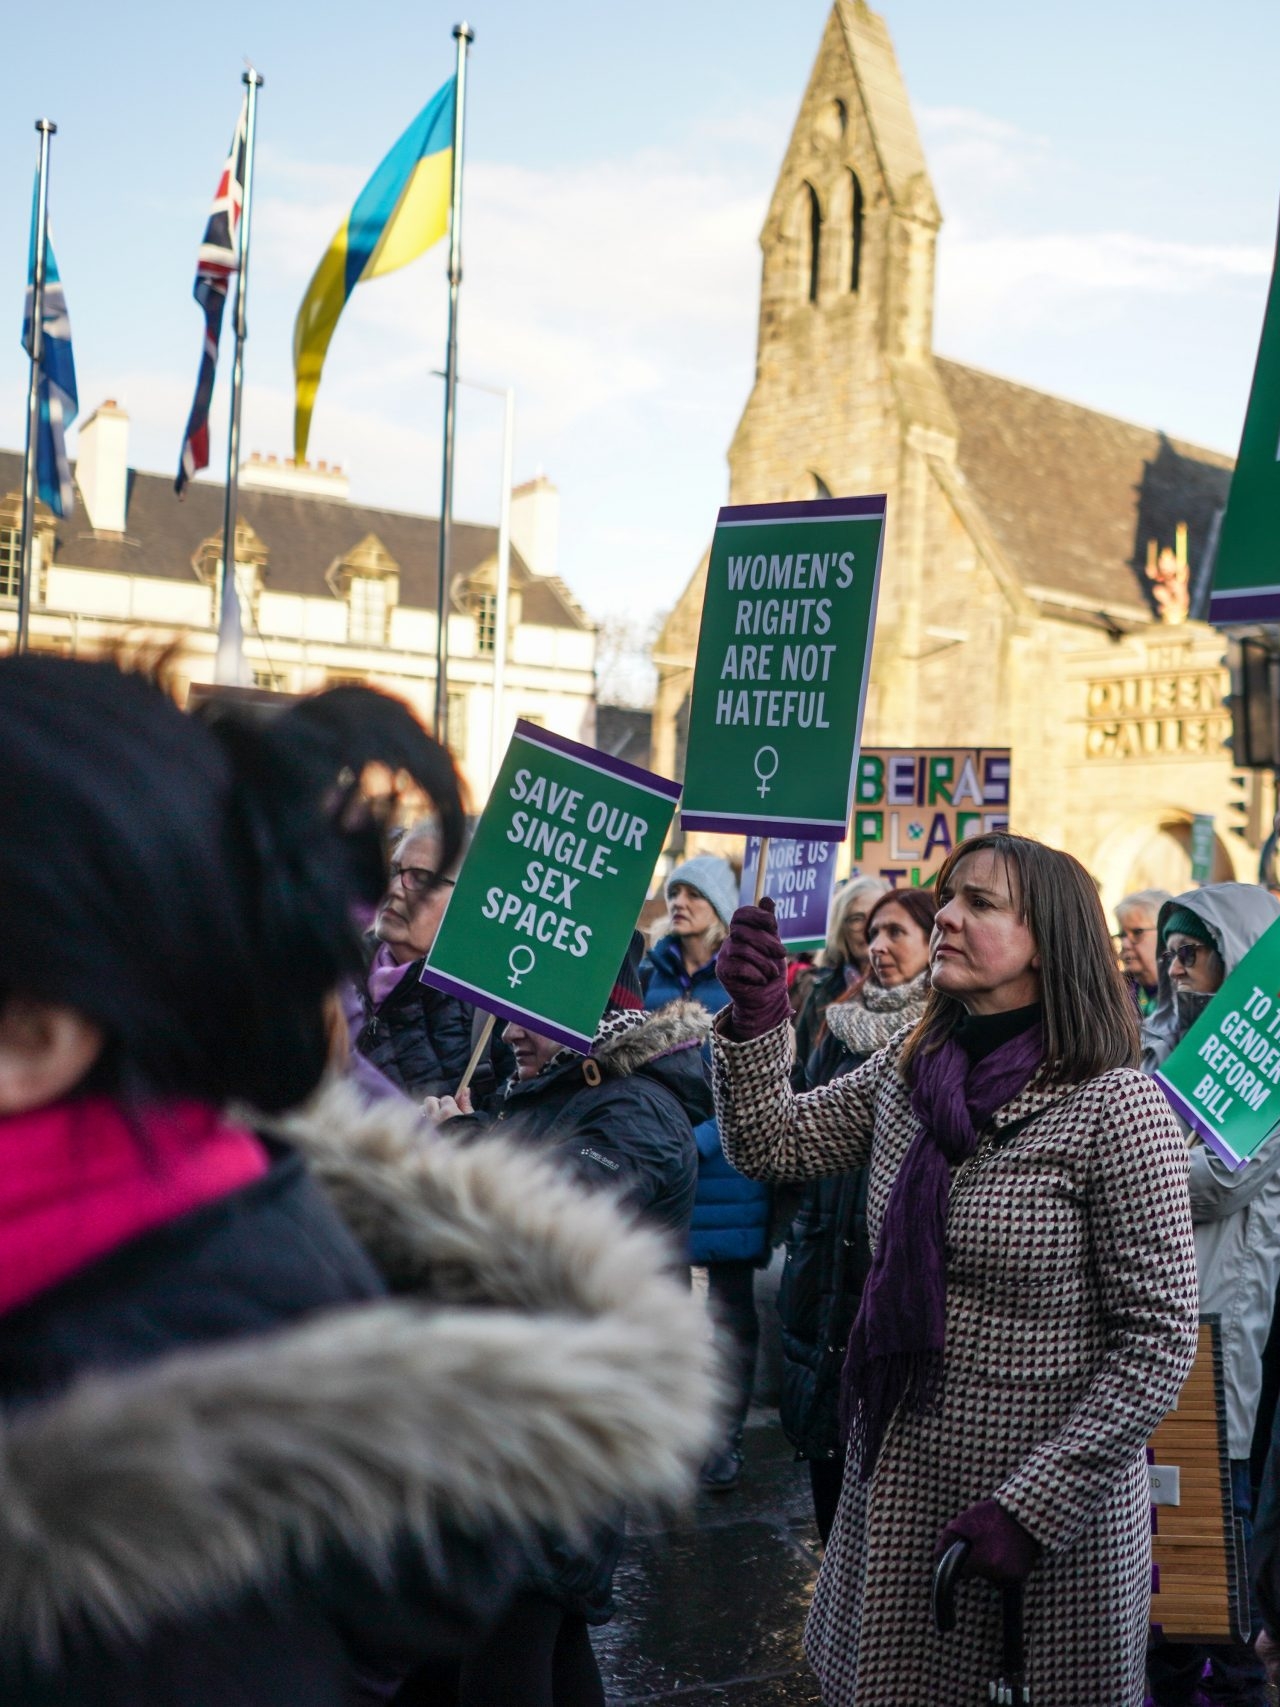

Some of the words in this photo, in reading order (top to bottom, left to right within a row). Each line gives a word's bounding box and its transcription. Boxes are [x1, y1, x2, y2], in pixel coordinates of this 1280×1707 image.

[727, 551, 855, 591] WOMEN'S
[735, 598, 833, 635] RIGHTS
[720, 645, 774, 681] ARE
[780, 645, 836, 682] NOT
[715, 689, 830, 729] HATEFUL
[1086, 717, 1233, 758] GALLER
[509, 768, 584, 824] SAVE
[586, 801, 649, 851] OUR
[506, 811, 619, 880] SINGLE-
[750, 844, 804, 873] INORE
[807, 841, 829, 865] US
[521, 861, 581, 910] SEX
[778, 868, 817, 894] YOUR
[481, 886, 593, 958] SPACES
[1243, 986, 1272, 1021] TO
[1198, 1033, 1272, 1112] REFORM
[1193, 1074, 1234, 1124] BILL
